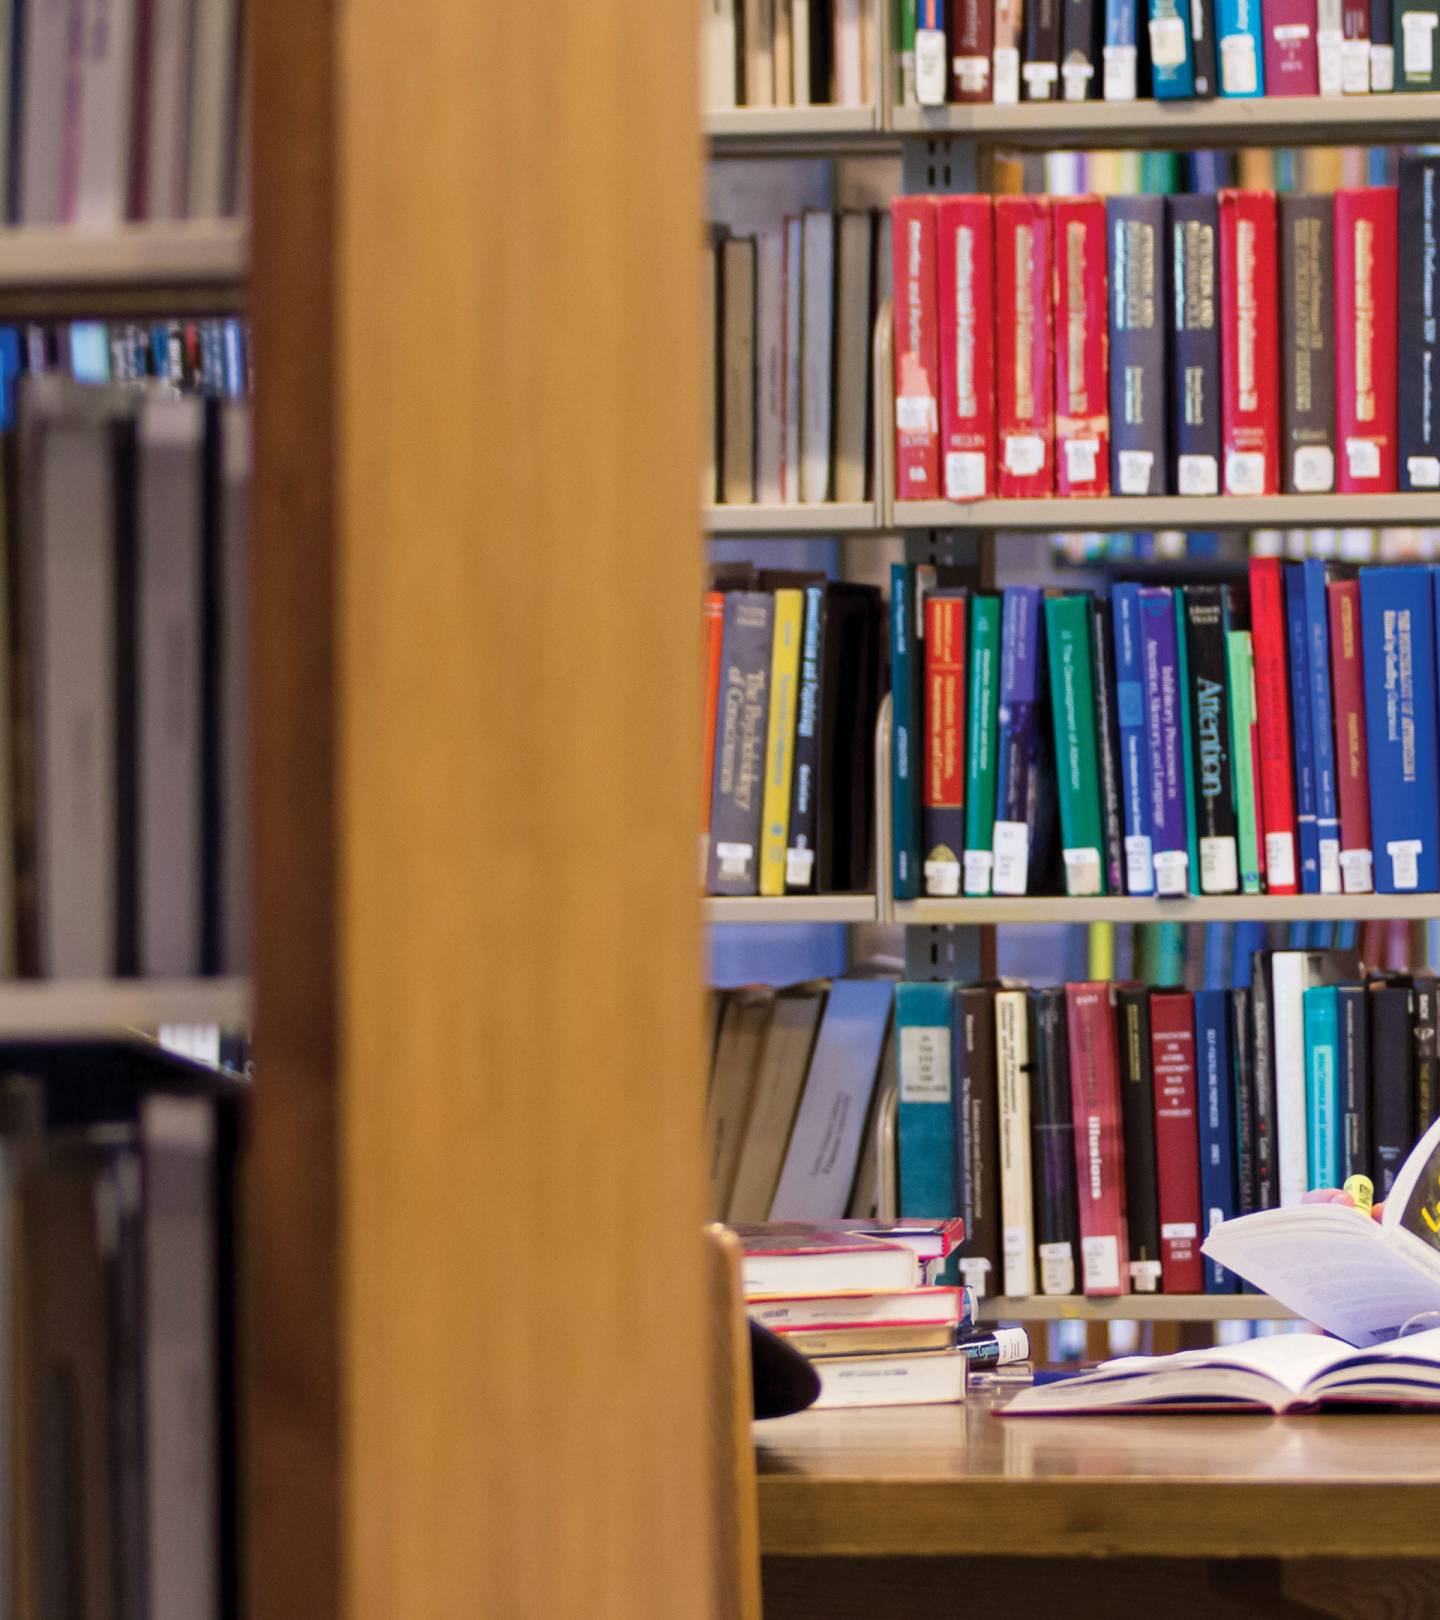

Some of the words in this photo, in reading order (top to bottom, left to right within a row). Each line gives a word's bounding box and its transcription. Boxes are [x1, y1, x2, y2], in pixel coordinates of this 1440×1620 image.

[1062, 644, 1074, 664] The
[1147, 639, 1161, 696] Attention,
[727, 666, 741, 686] of
[744, 671, 766, 702] The
[1063, 665, 1077, 730] Development
[1161, 666, 1176, 723] Inhibitory
[1069, 732, 1078, 743] of
[1149, 697, 1162, 748] Memory,
[1196, 676, 1228, 797] Attention
[932, 736, 943, 758] and
[1152, 751, 1163, 769] and
[1164, 726, 1178, 782] Processes
[1069, 745, 1081, 790] Attention
[1153, 771, 1166, 829] Language
[1168, 787, 1178, 798] in
[1001, 1035, 1010, 1051] and
[1009, 1046, 1017, 1062] and
[1256, 1050, 1267, 1061] of
[1001, 1053, 1012, 1116] Contemporary
